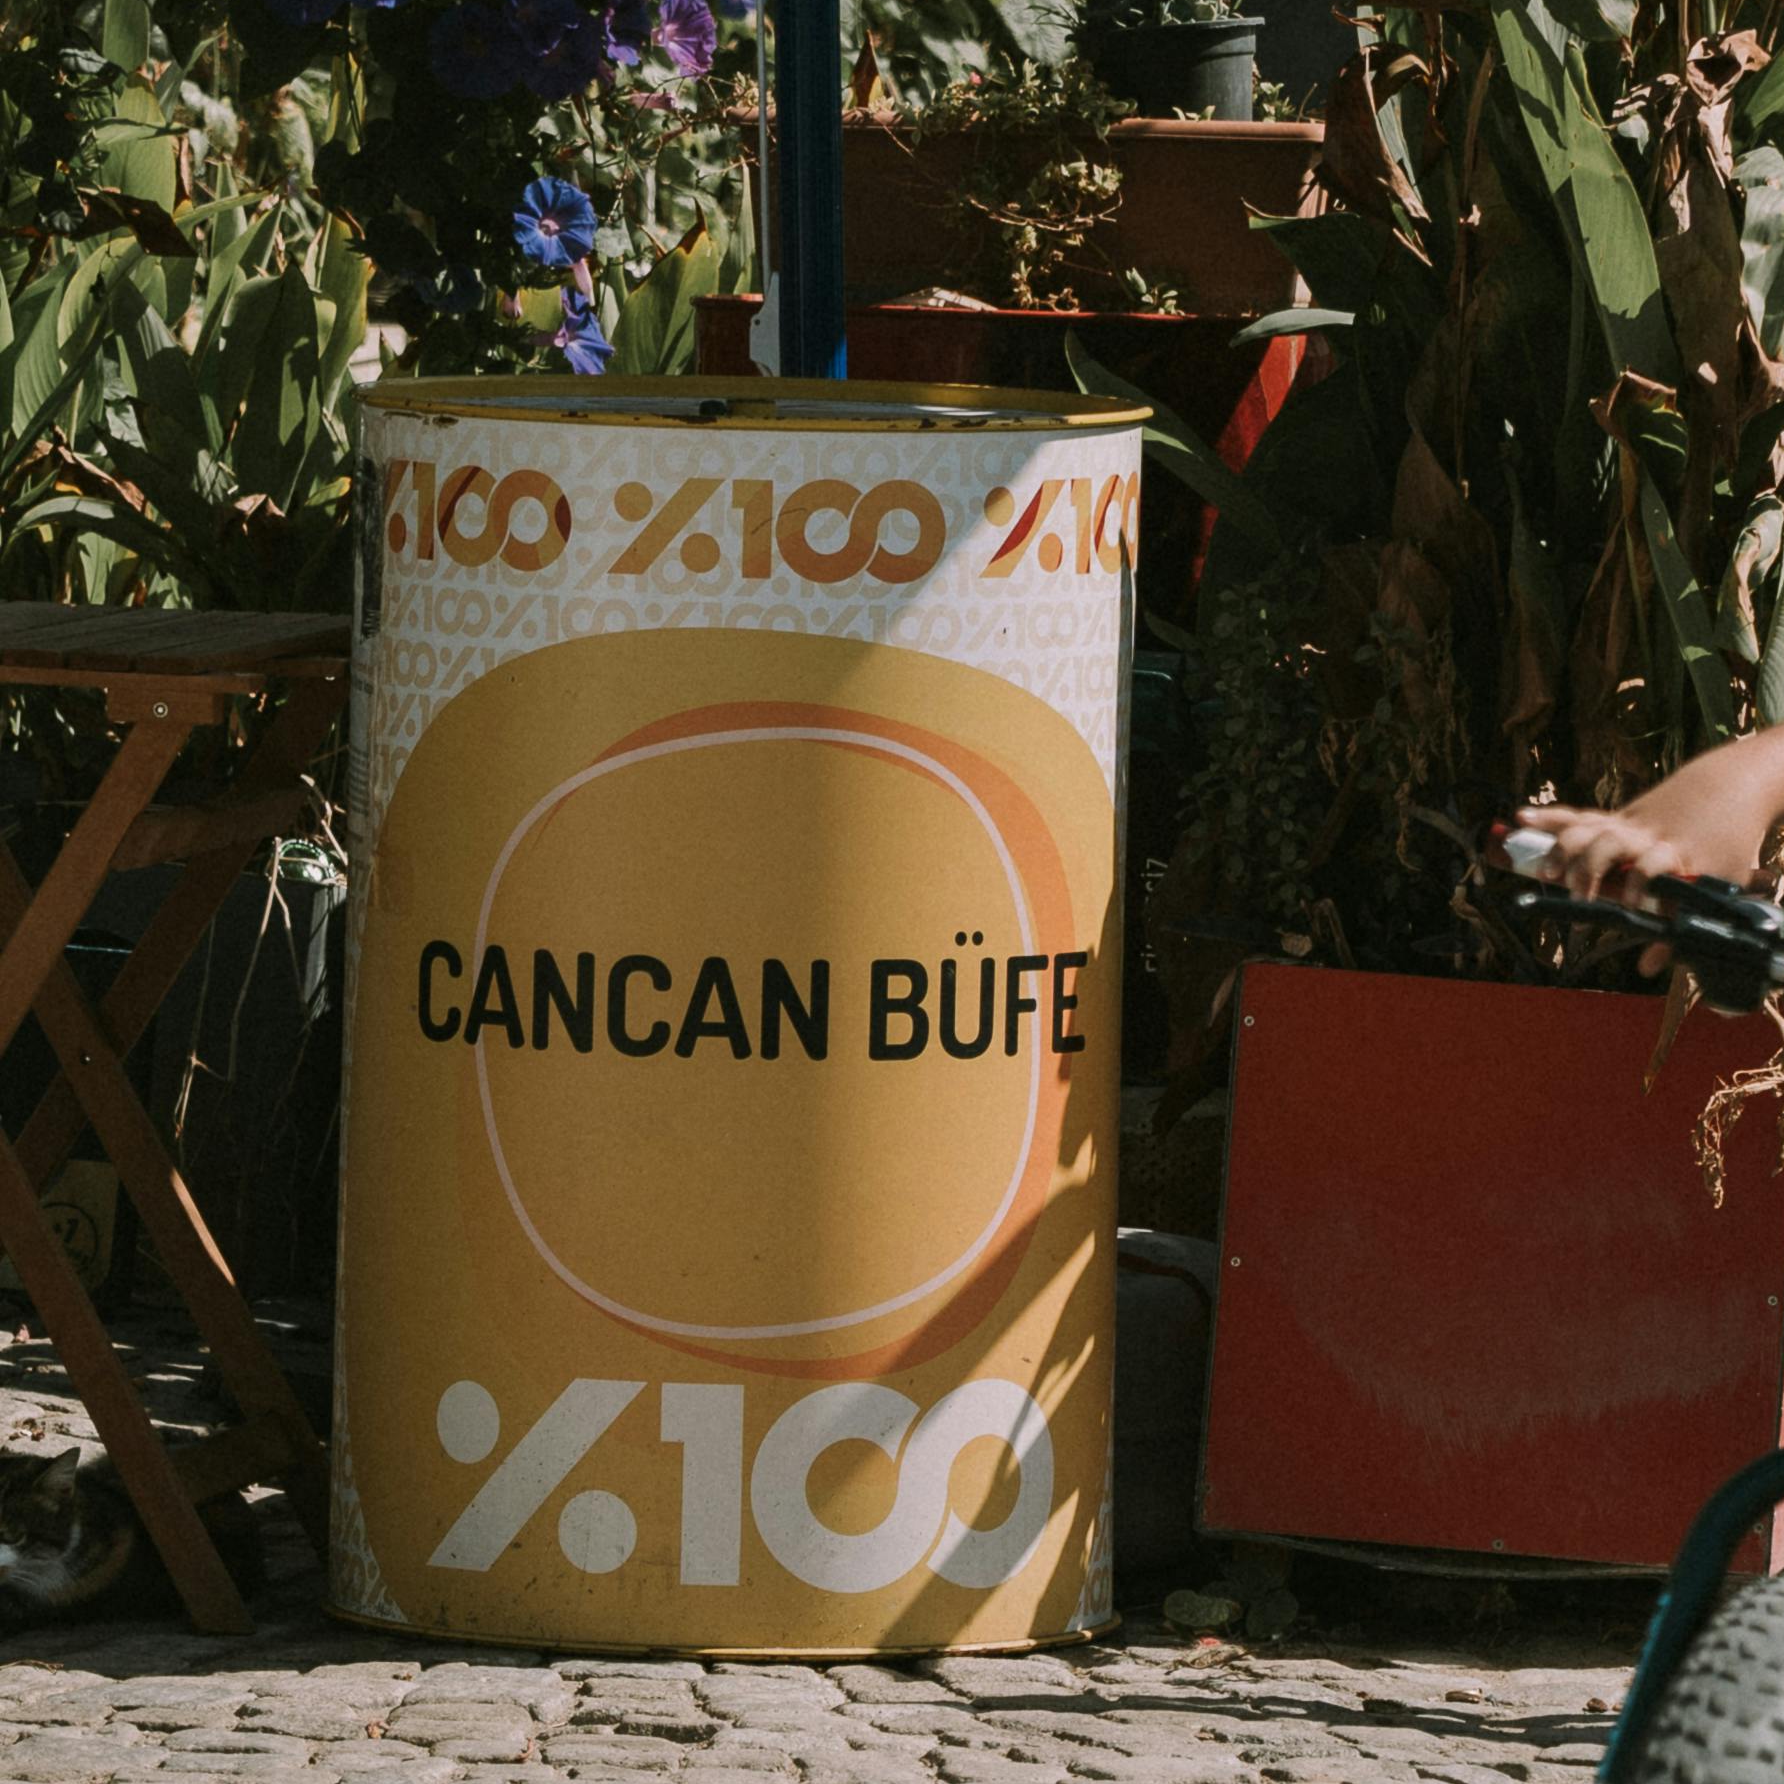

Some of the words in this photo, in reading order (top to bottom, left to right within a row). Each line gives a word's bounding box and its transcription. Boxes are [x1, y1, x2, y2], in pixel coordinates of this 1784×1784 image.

[607, 478, 946, 584] %100
[418, 940, 830, 1061] CANCAN
[868, 930, 1088, 1060] BÜFE
[427, 1378, 1053, 1593] %100
